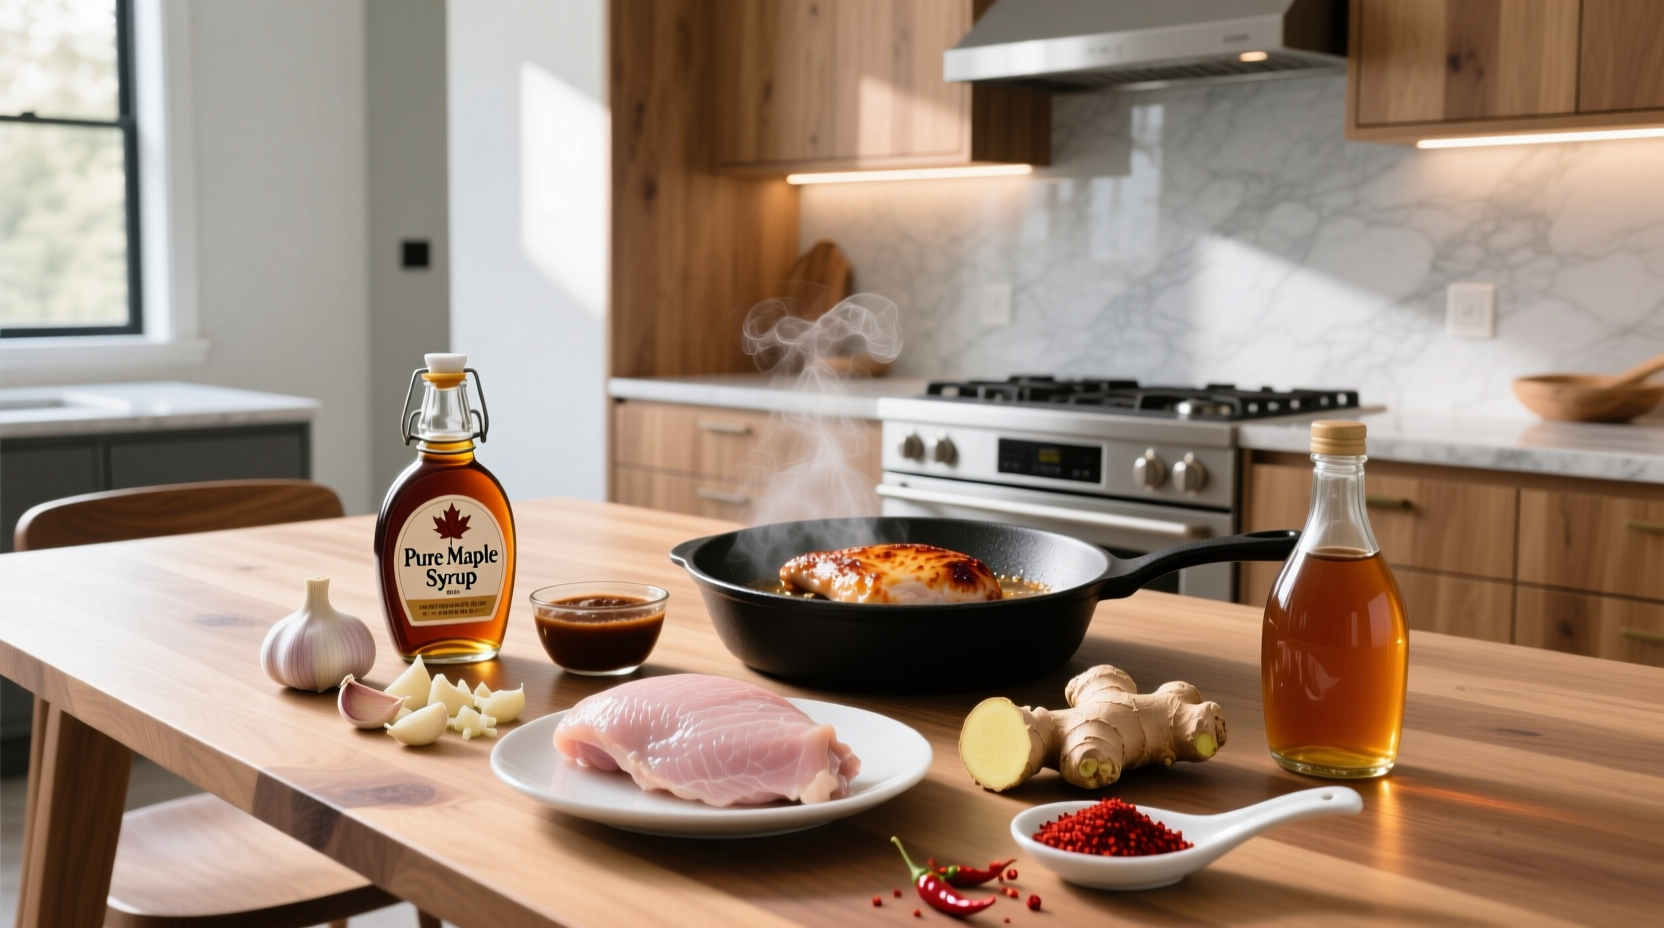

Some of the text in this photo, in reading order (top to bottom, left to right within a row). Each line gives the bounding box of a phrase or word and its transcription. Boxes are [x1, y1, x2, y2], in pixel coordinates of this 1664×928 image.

[404, 544, 498, 568] Pure Maple
[426, 568, 477, 591] Syrup
